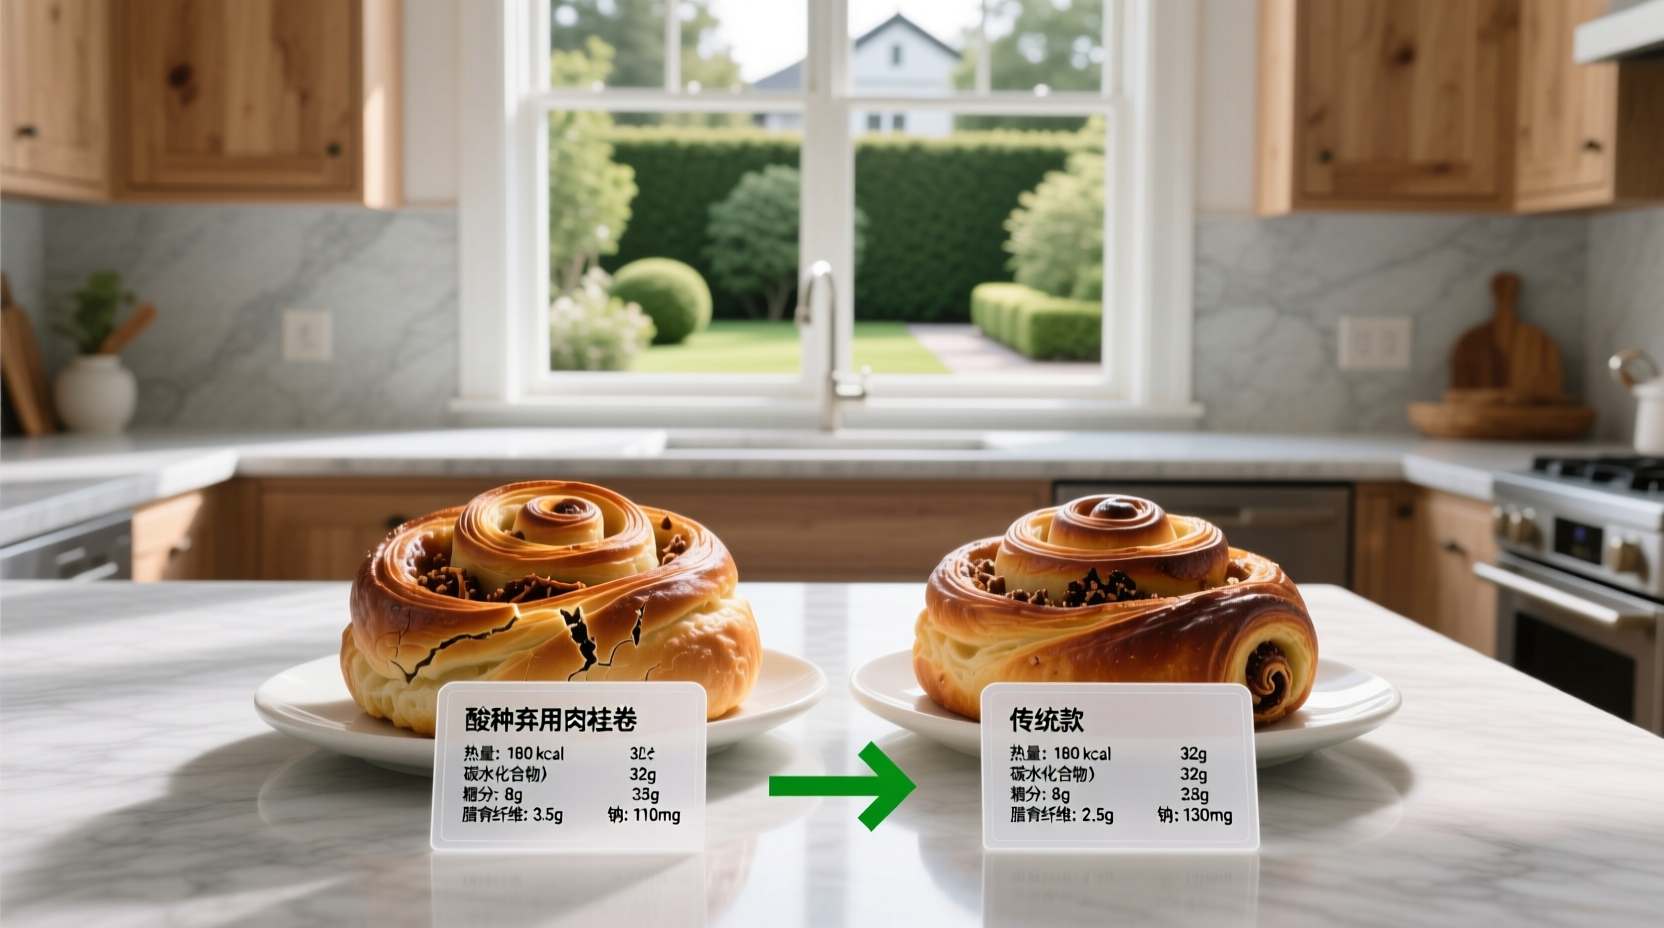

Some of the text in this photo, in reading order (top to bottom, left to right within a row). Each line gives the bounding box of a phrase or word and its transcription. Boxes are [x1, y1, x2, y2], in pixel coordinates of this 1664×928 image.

[465, 705, 638, 733] 酸种弃用肉桂卷
[1009, 706, 1085, 733] 传统款
[507, 745, 534, 761] 180
[535, 745, 565, 761] kcal
[1054, 745, 1080, 760] 180
[1083, 746, 1112, 762] kcal
[1180, 746, 1207, 764] 32g
[629, 766, 657, 785] 32g
[1179, 766, 1208, 785] 32g
[504, 786, 523, 805] 8g
[1051, 786, 1071, 805] 8g
[532, 806, 564, 826] 3.5g
[633, 807, 681, 826] 110mg
[1081, 806, 1114, 826] 2.5g
[1183, 807, 1233, 826] 130mg
